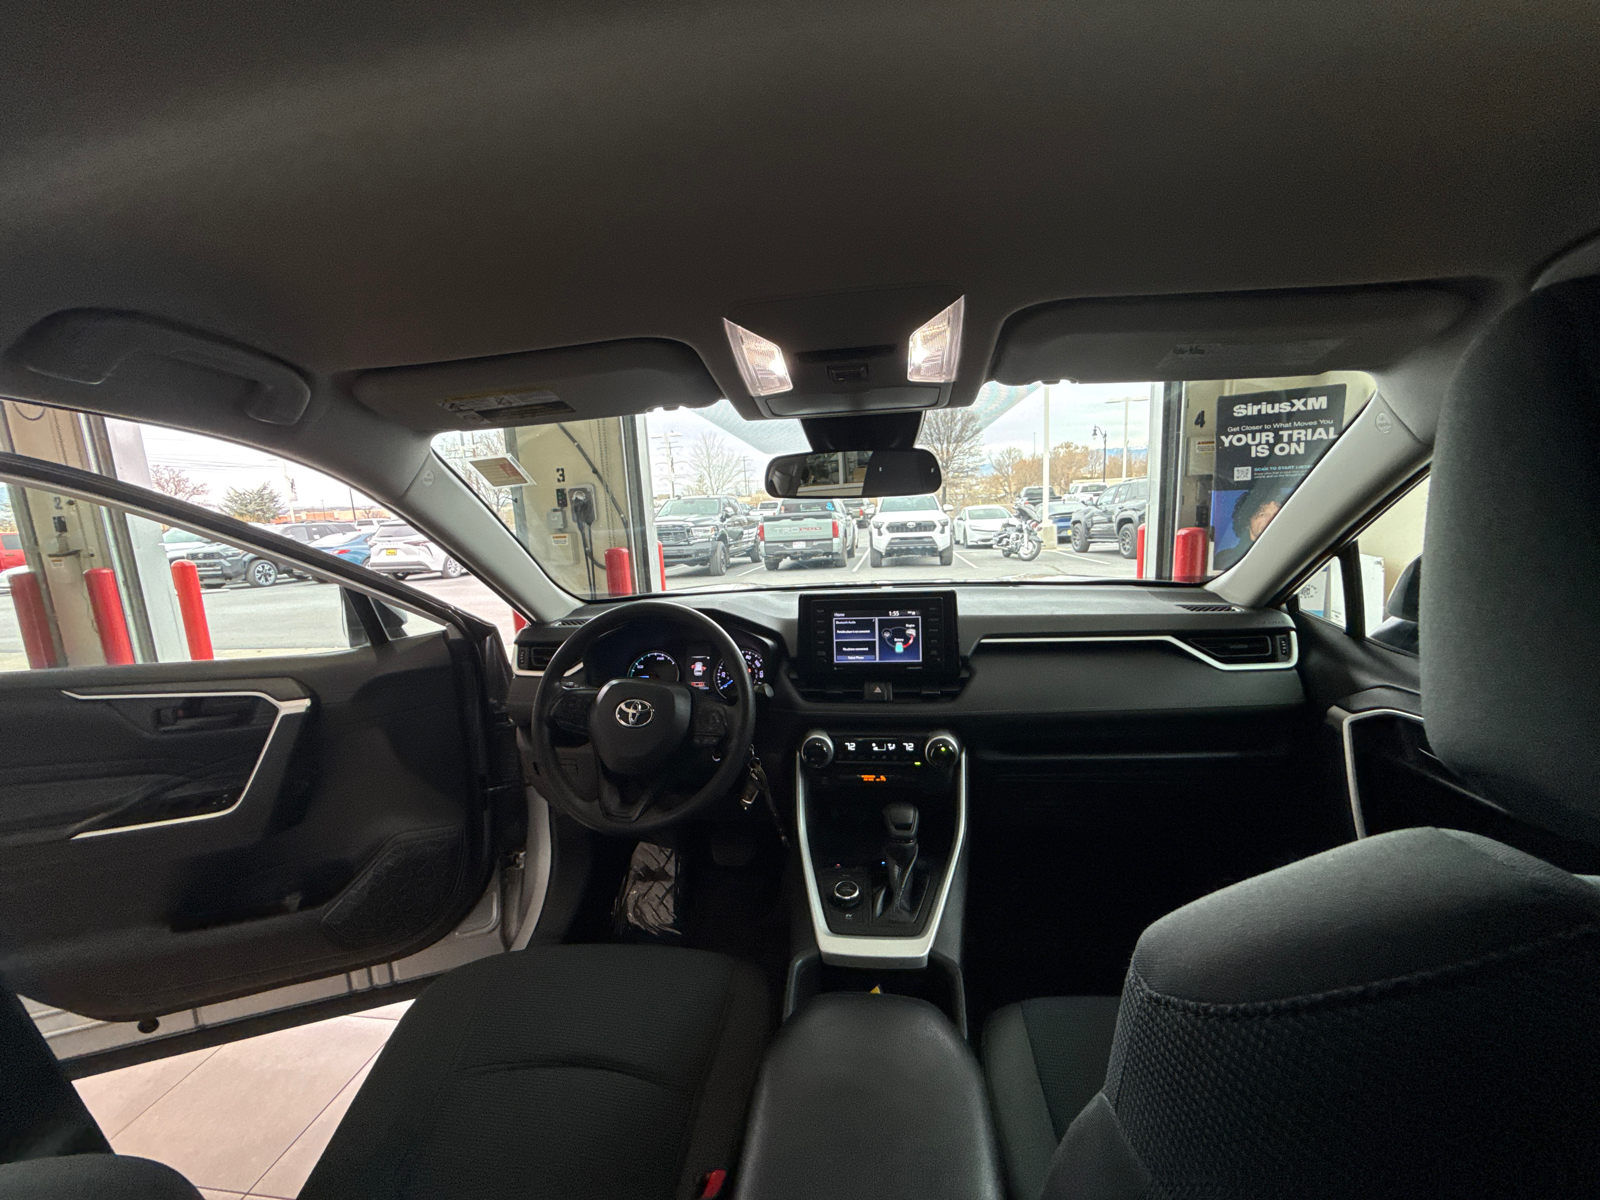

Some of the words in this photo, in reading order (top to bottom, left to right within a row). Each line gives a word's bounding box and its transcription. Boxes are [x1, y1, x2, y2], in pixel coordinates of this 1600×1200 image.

[1233, 396, 1328, 416] SiriusXM
[1194, 410, 1206, 428] 4
[1240, 424, 1263, 432] Closer
[1294, 419, 1318, 427] Moves
[1220, 432, 1274, 447] YOUR
[1280, 427, 1338, 442] TRIAL
[1250, 444, 1270, 458] IS
[1274, 442, 1305, 456] ON
[556, 468, 566, 482] 3
[54, 496, 63, 510] 2
[845, 742, 856, 751] 72
[903, 743, 914, 751] 72
